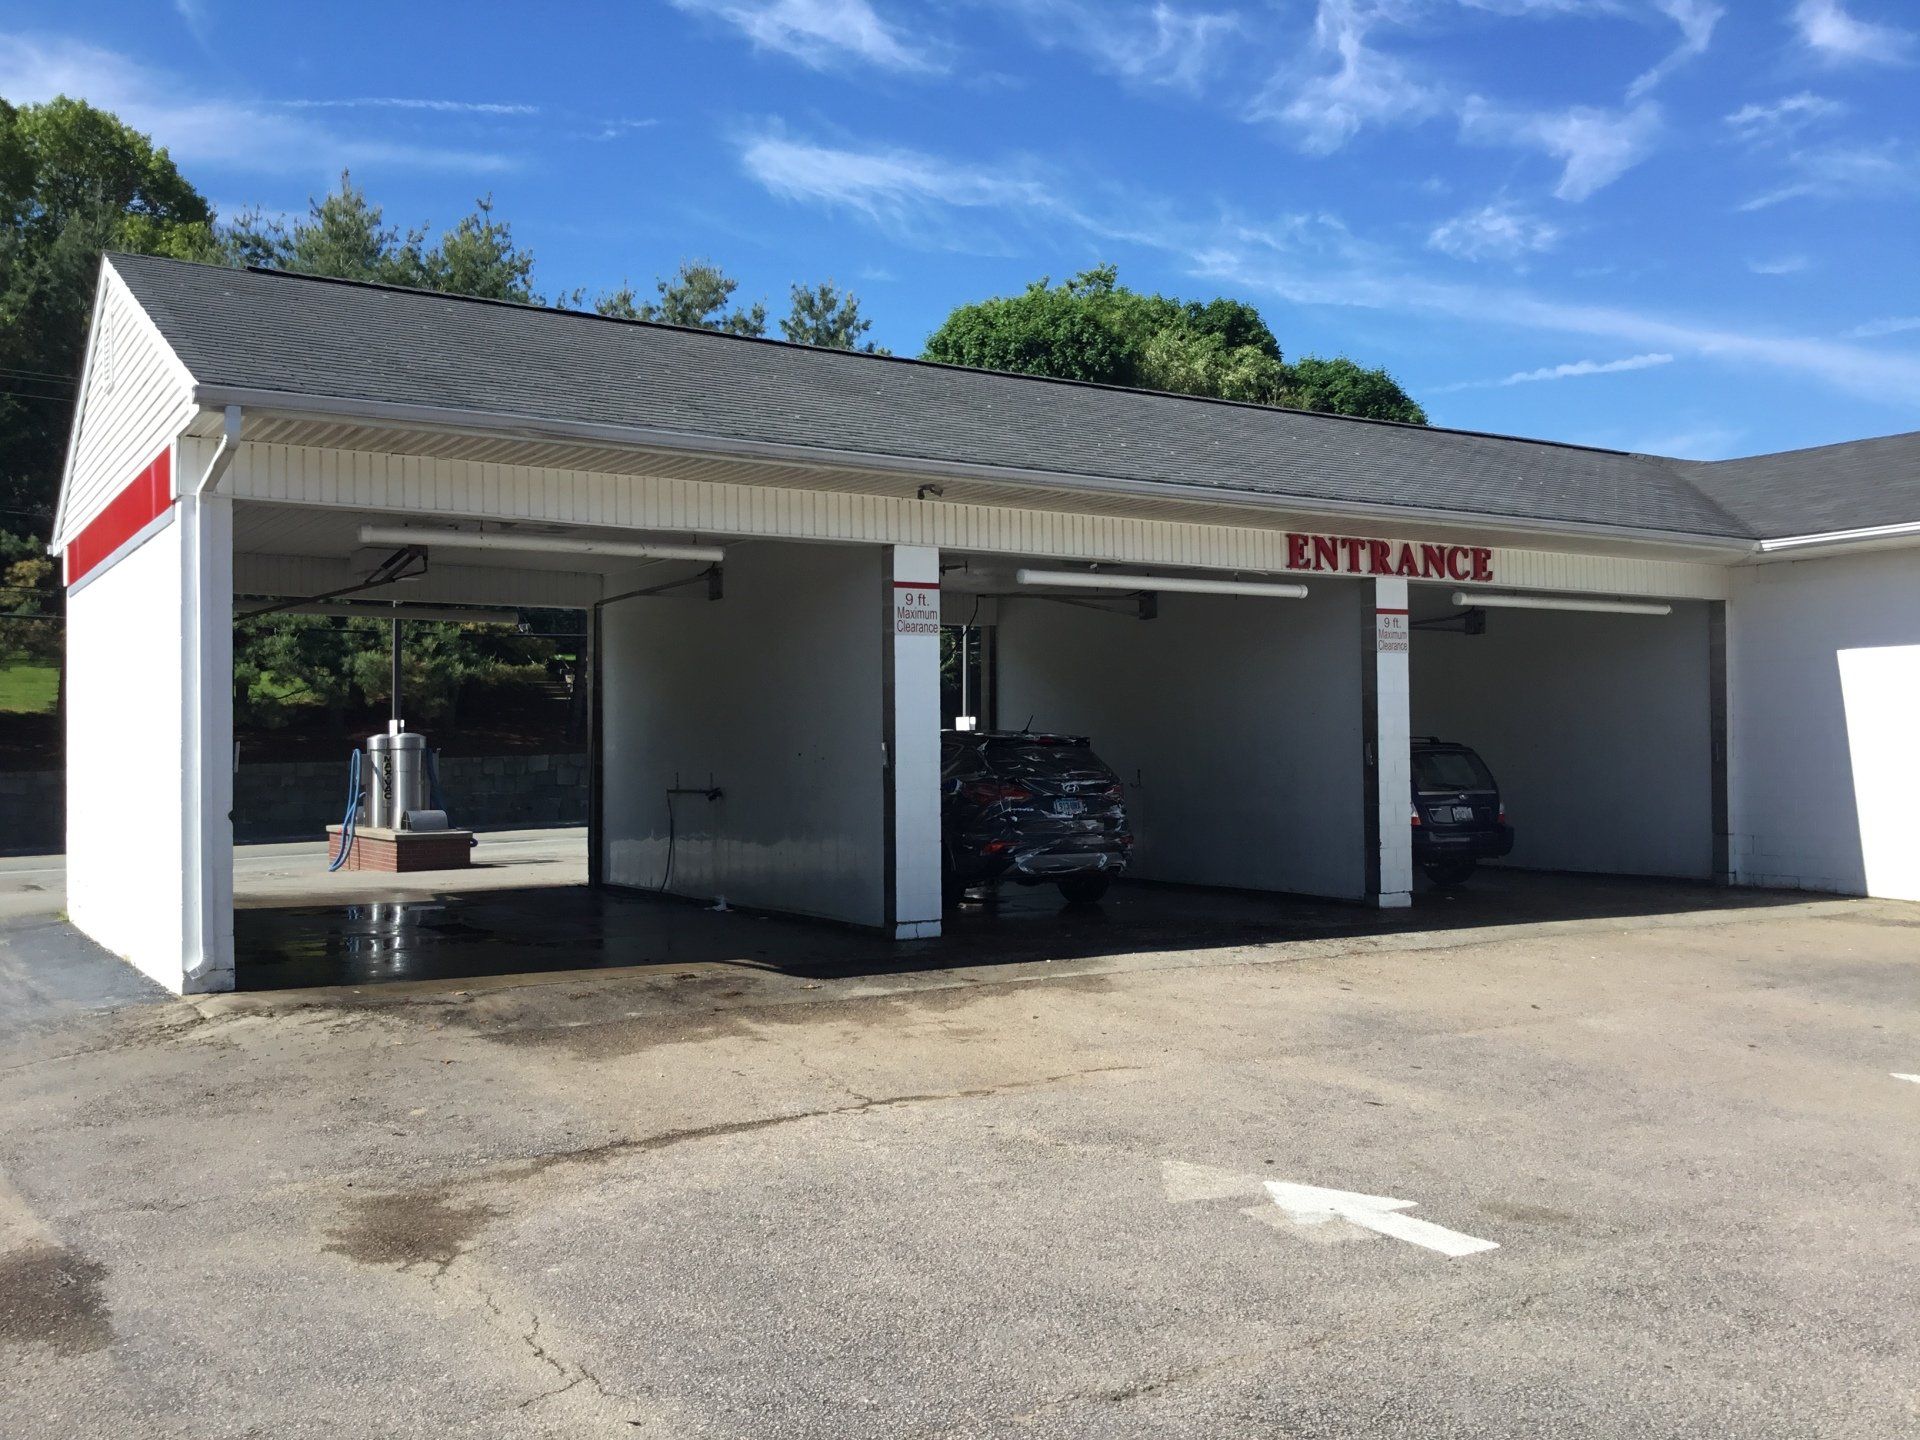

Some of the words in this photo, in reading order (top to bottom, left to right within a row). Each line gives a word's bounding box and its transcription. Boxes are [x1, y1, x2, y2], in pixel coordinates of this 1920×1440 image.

[1286, 533, 1493, 582] ENTRANCE
[905, 593, 914, 606] 9
[917, 592, 930, 607] ft.
[897, 606, 938, 620] Maximum
[896, 619, 938, 633] Clearance
[1383, 617, 1390, 628] 9
[1378, 639, 1408, 651] Clearance
